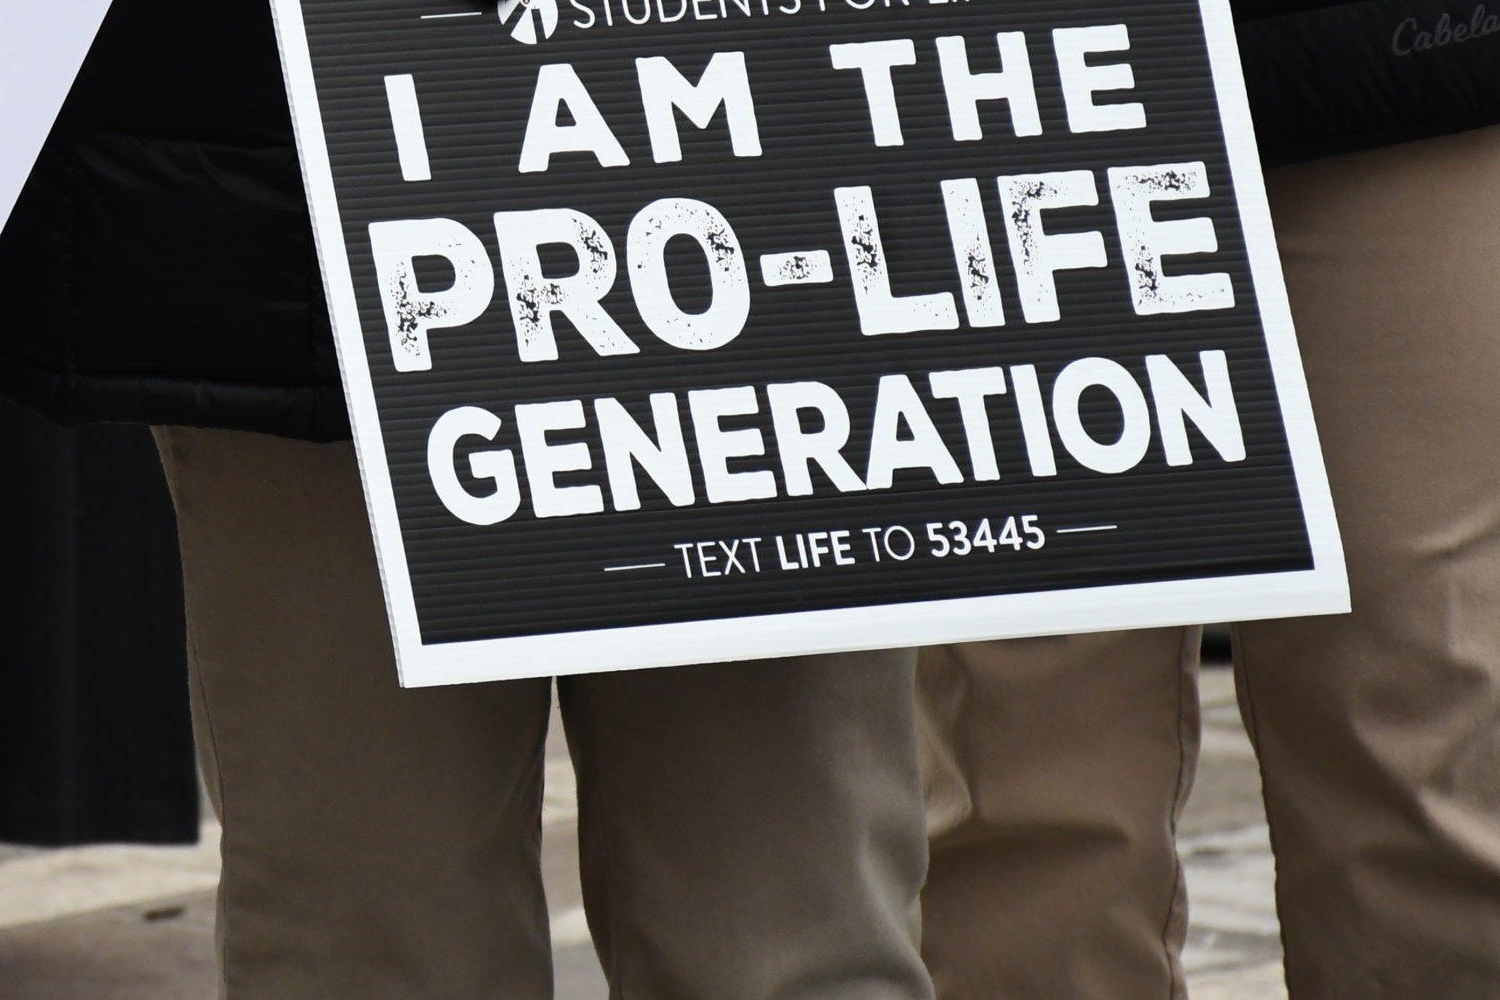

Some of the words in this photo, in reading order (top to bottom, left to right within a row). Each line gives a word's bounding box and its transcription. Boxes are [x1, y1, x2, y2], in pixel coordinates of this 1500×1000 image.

[384, 73, 432, 182] I
[518, 52, 763, 174] AM
[828, 23, 1147, 147] THE
[368, 160, 1236, 373] PRO-LIFE
[426, 349, 1247, 526] GENERATION
[673, 538, 762, 579] TEXT
[776, 530, 856, 571] LIFE
[862, 525, 915, 562] TO
[927, 514, 1046, 558] 53445
